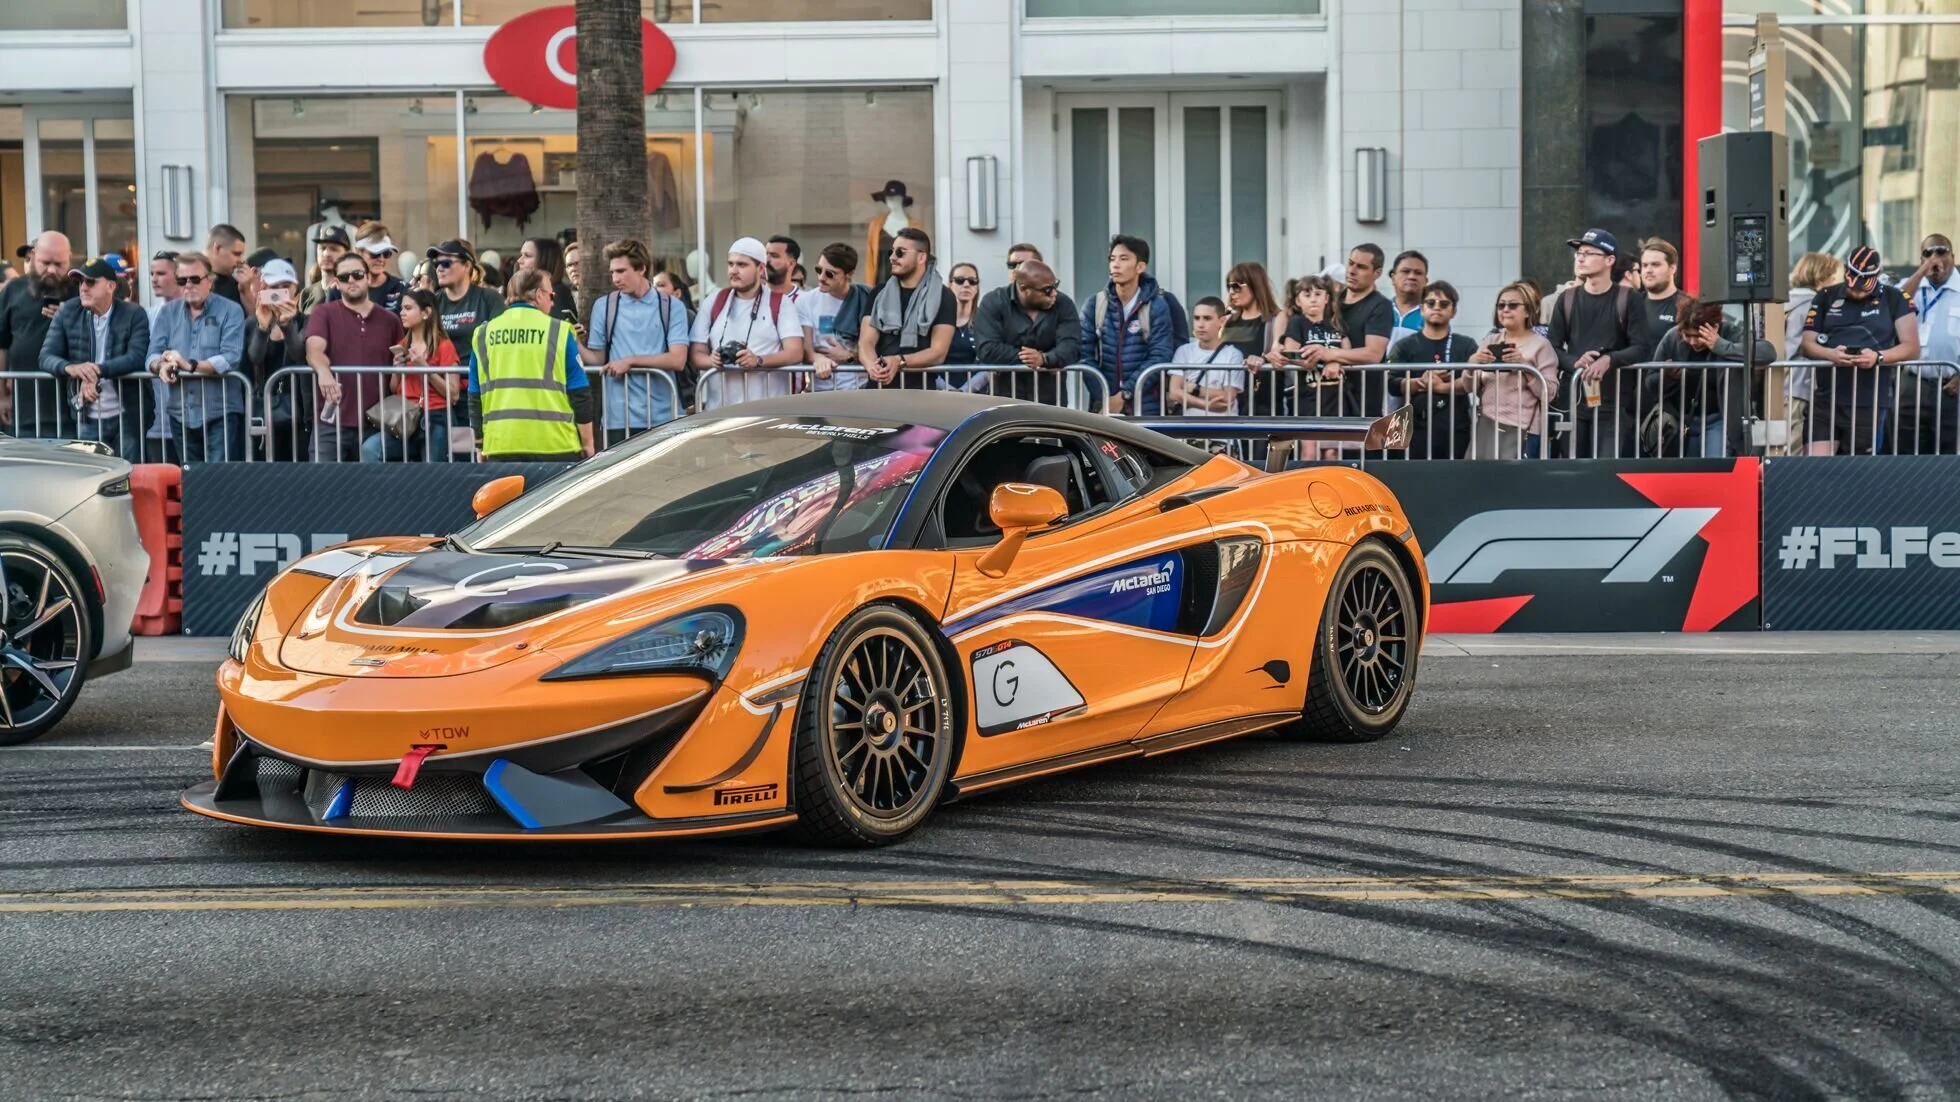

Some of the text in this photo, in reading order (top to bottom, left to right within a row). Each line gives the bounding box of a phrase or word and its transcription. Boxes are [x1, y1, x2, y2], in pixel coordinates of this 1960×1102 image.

[489, 329, 545, 346] SECURITY
[766, 423, 880, 436] McLaren
[842, 432, 870, 440] HILLS
[1344, 504, 1377, 517] RICHARD
[1779, 526, 1960, 569] #F1Fe
[1109, 569, 1171, 595] McLaren
[1662, 575, 1674, 583] TM
[1146, 583, 1171, 596] SAN DIEGO
[993, 660, 1019, 707] G
[1017, 715, 1049, 730] McLaren
[431, 726, 470, 740] TOW
[714, 783, 778, 806] PIRELLI
